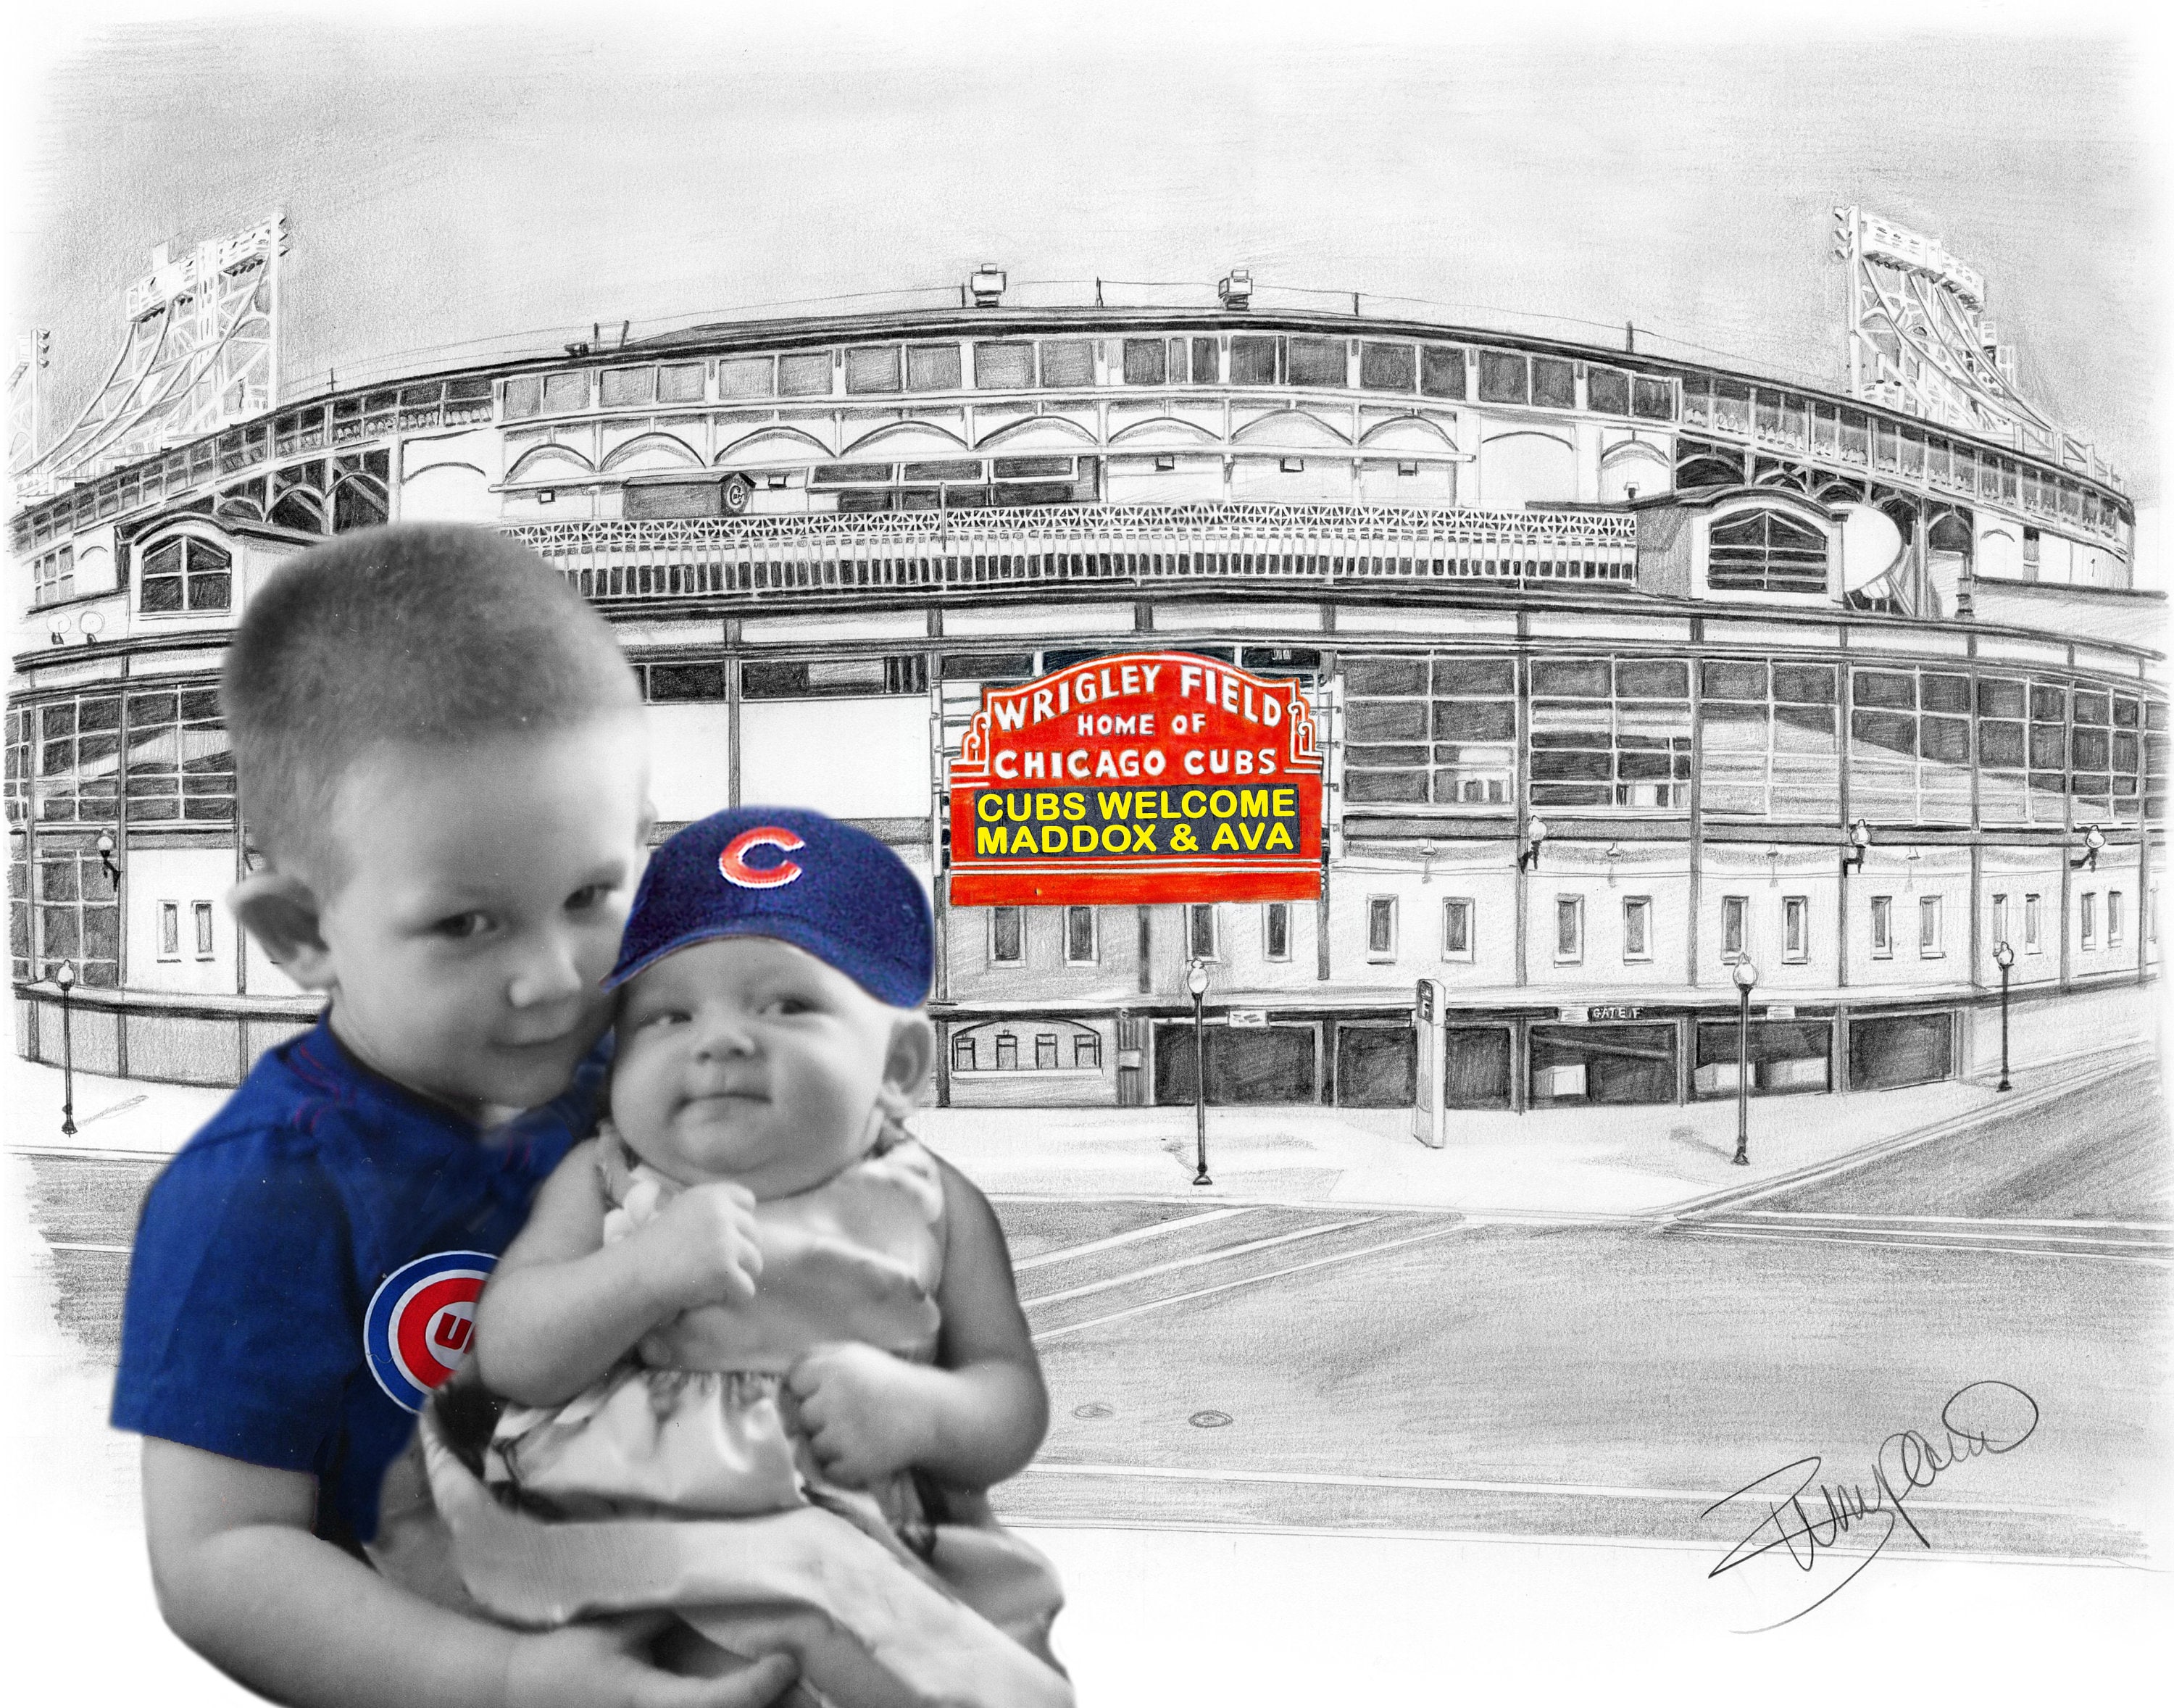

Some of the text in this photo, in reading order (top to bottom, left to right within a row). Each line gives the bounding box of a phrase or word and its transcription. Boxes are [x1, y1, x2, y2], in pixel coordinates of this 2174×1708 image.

[994, 664, 1282, 732] WRIGLEY FIELD
[1078, 712, 1206, 736] HOME OF
[994, 748, 1277, 779] CHICAGO CUBS
[978, 788, 1296, 822] CUBS WELCOME
[977, 822, 1294, 854] MADDOX & AVA
[719, 825, 806, 889] C
[1594, 1007, 1626, 1019] GATE
